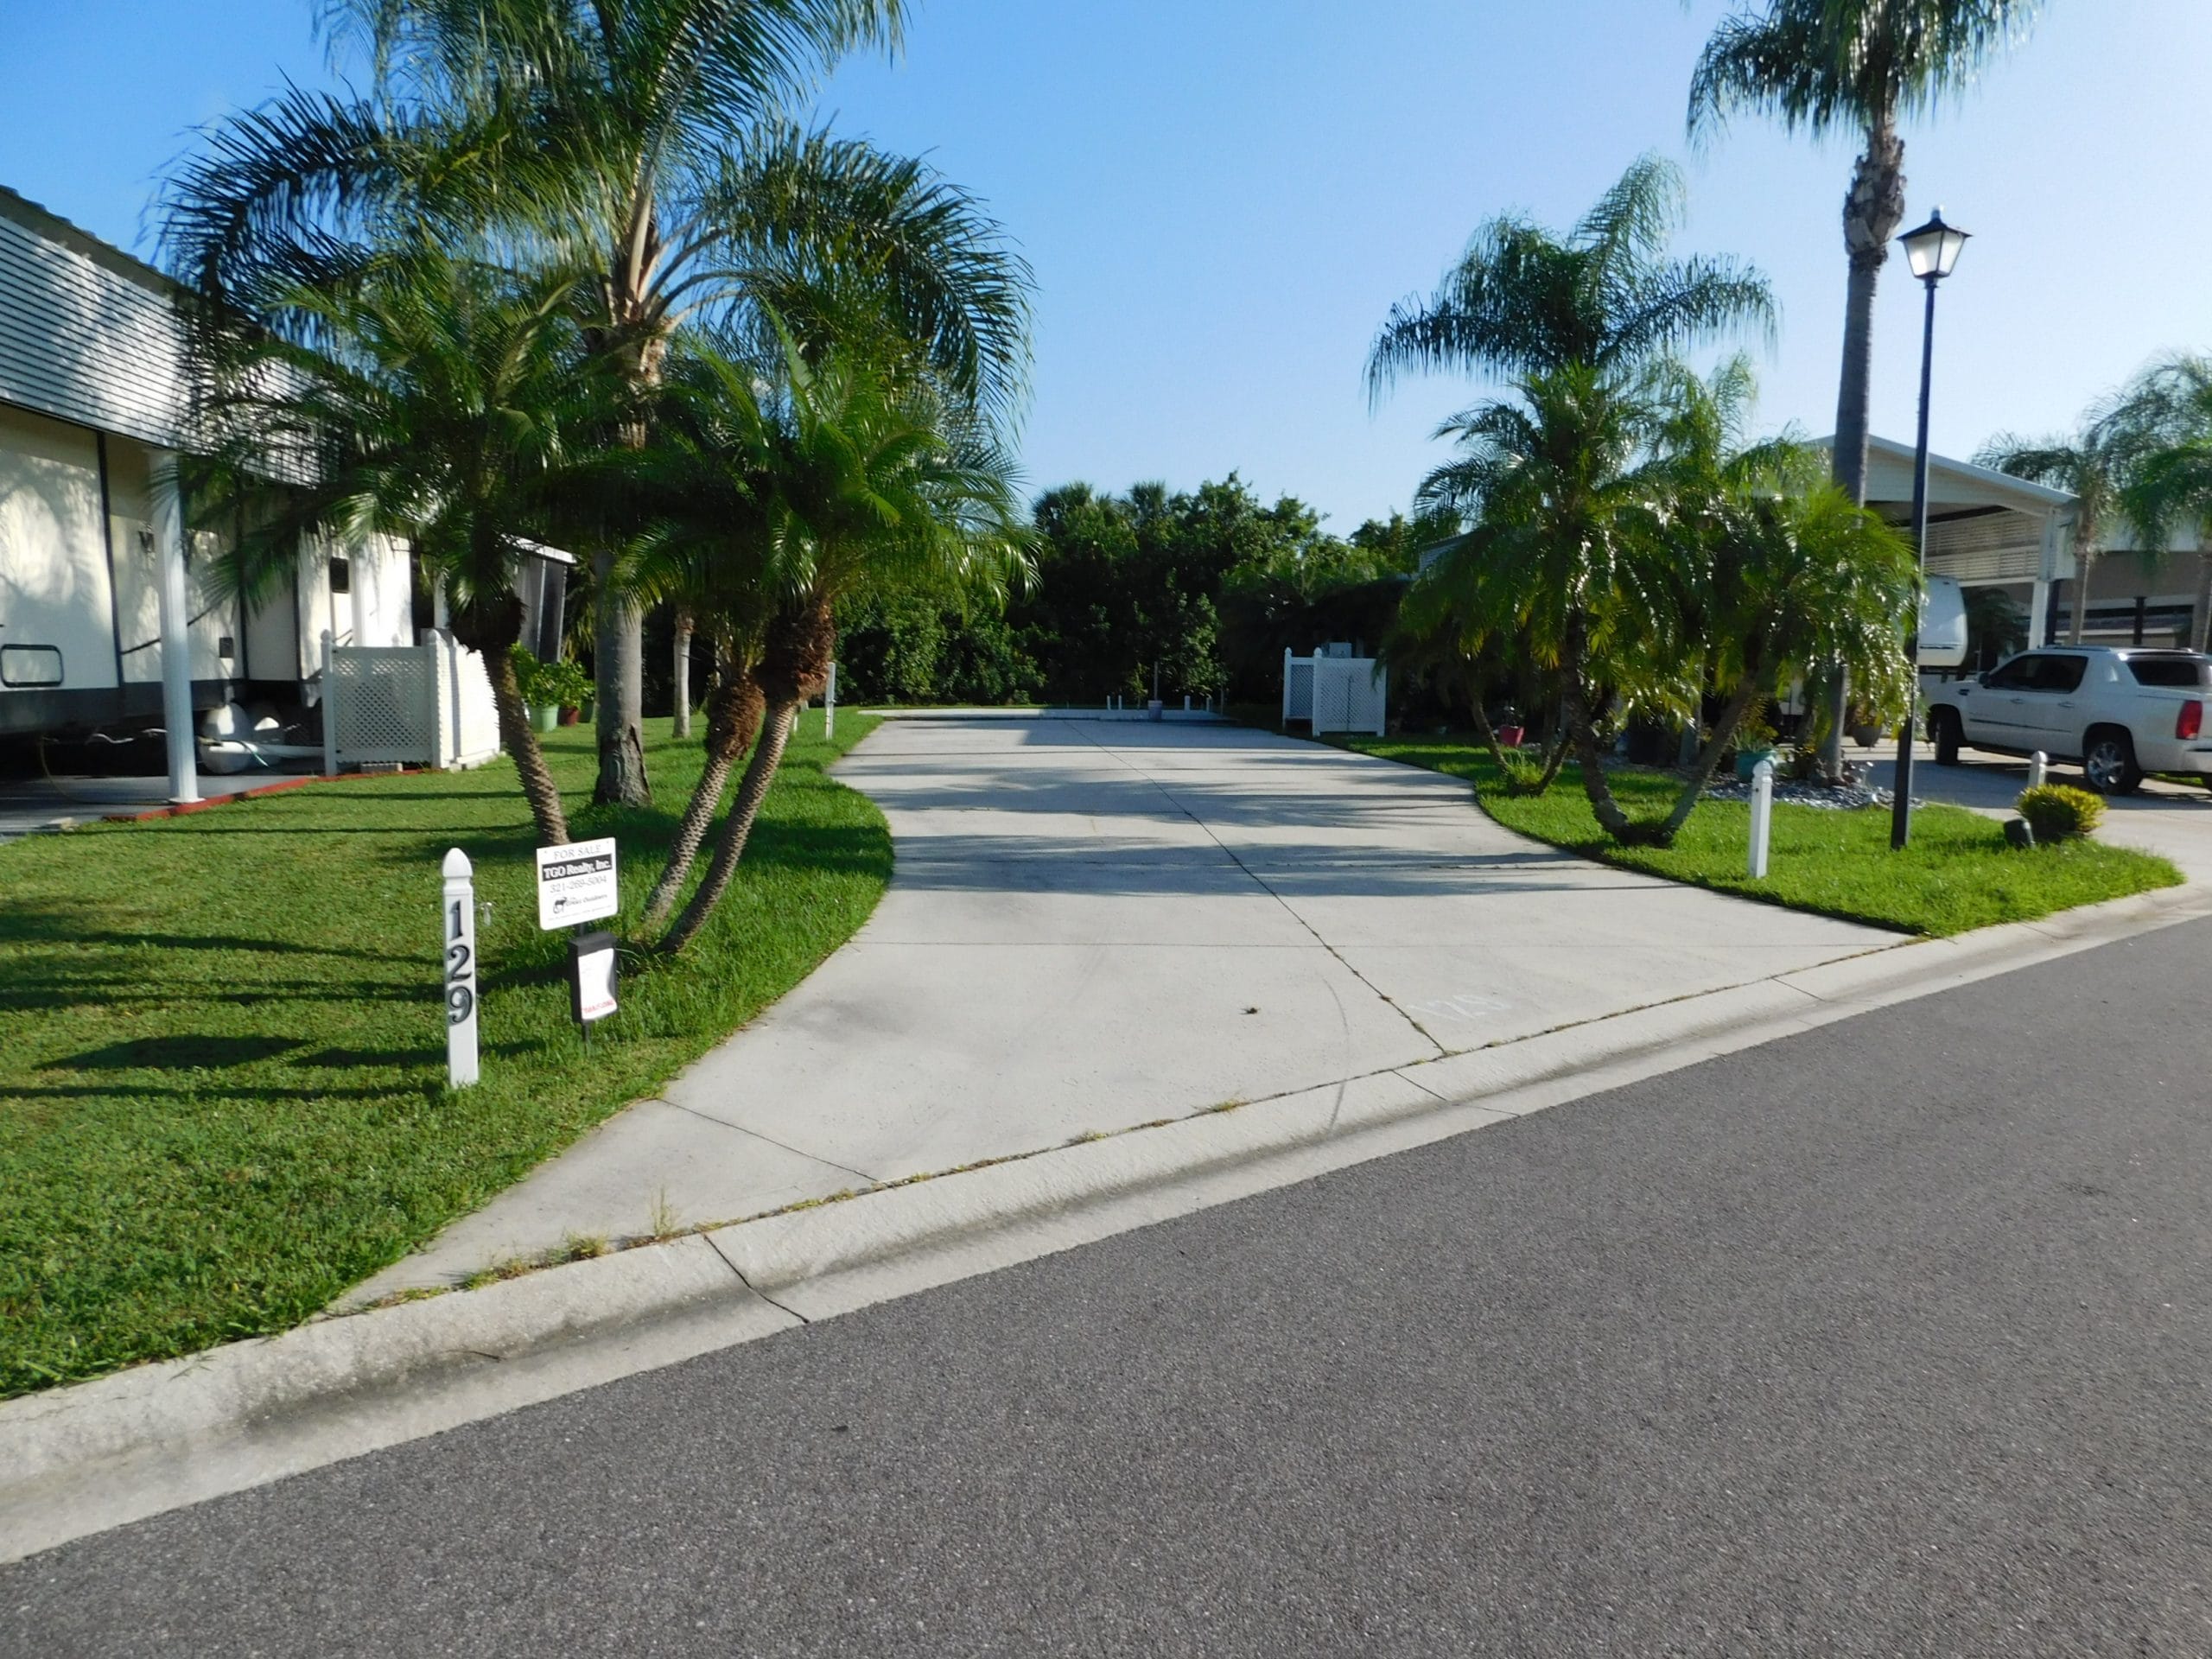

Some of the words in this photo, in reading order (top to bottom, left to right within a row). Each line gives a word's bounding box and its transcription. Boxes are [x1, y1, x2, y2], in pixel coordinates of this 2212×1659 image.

[554, 849, 575, 860] FOR
[577, 844, 601, 857] SALE
[543, 865, 566, 879] TGO
[595, 859, 611, 869] Inc.
[447, 899, 474, 1026] 129
